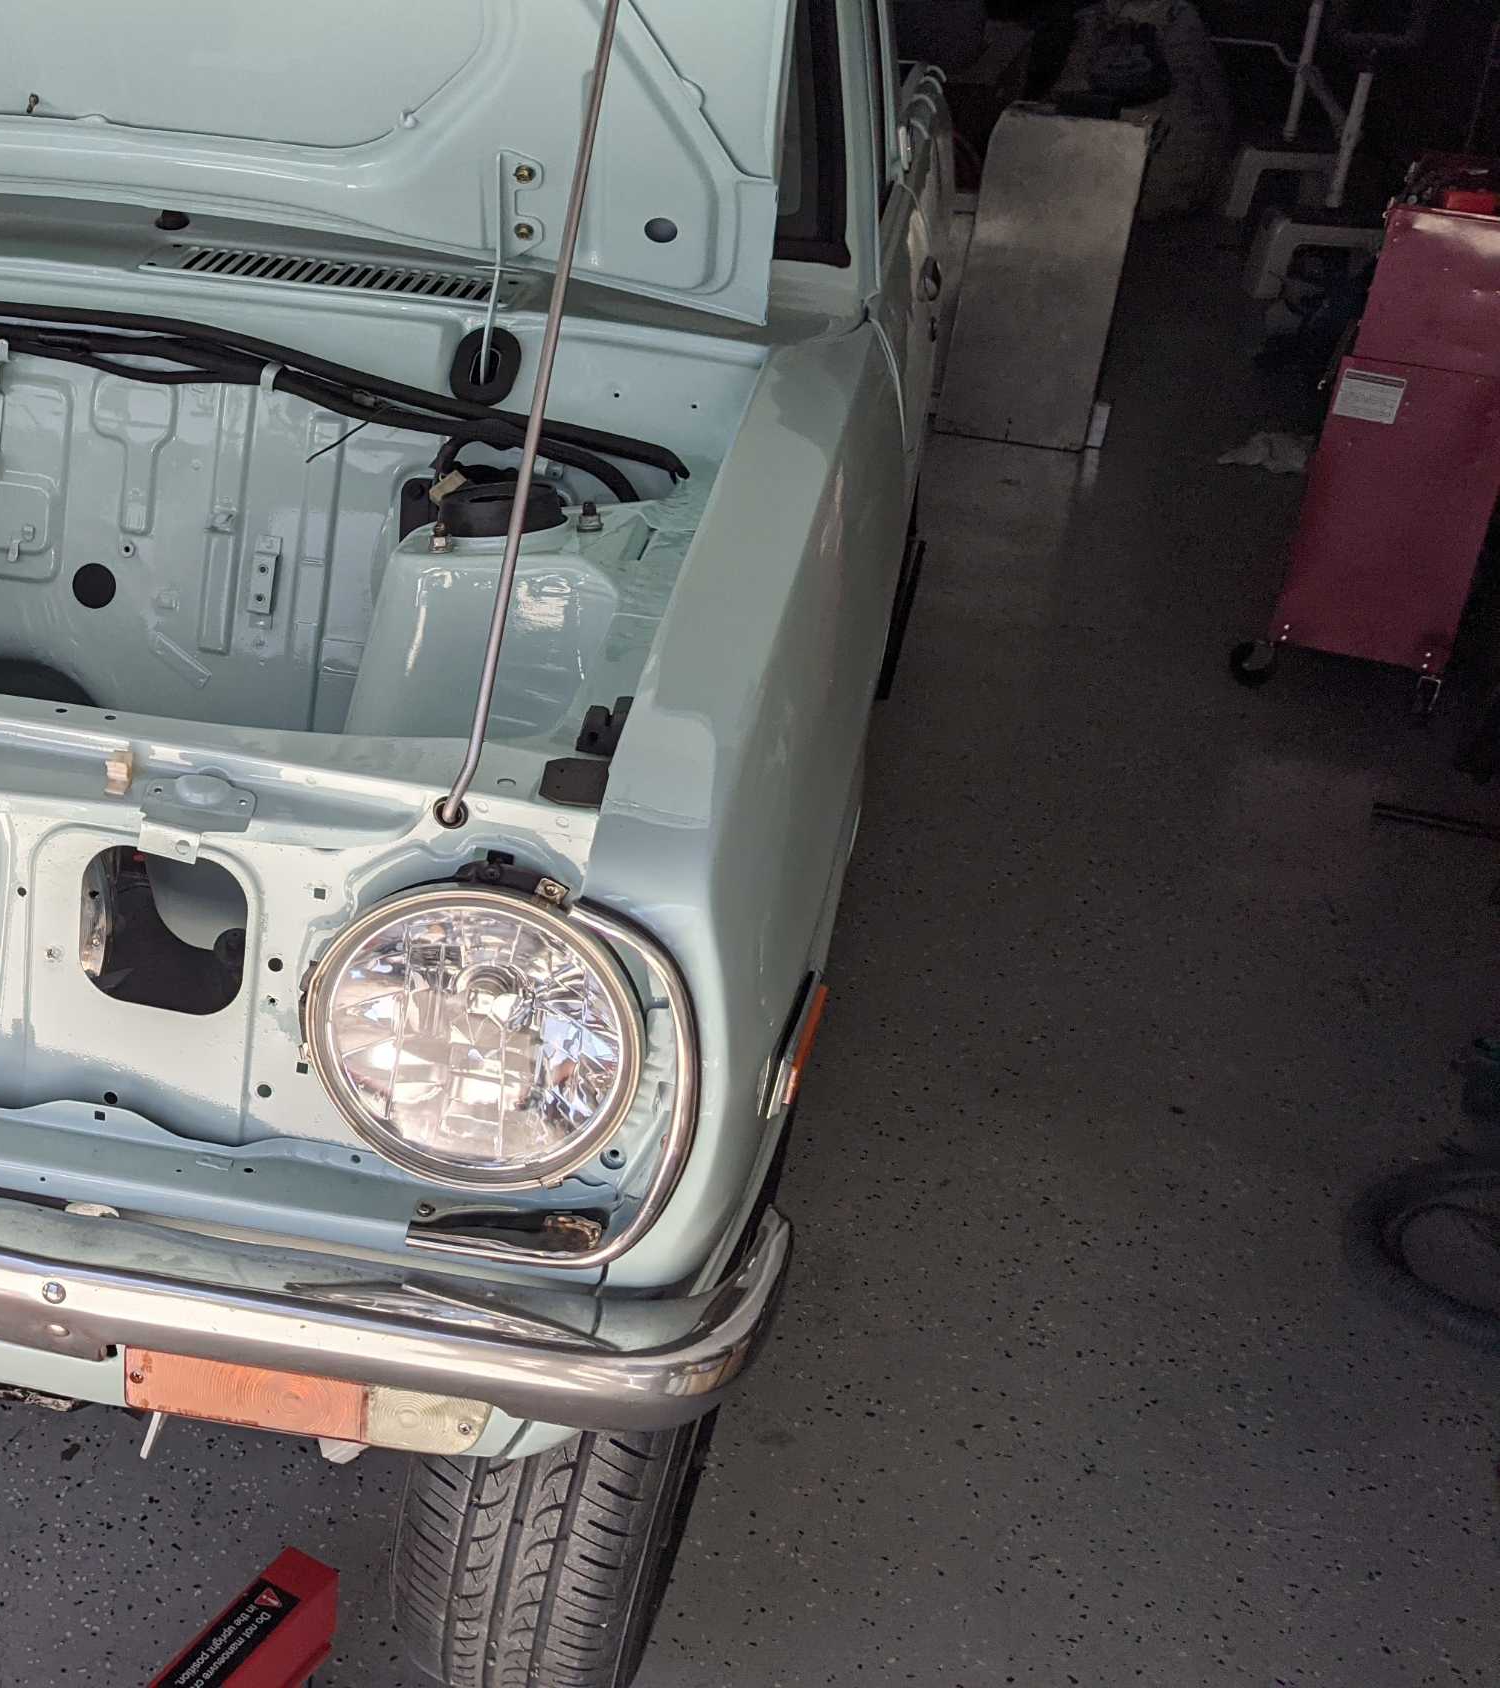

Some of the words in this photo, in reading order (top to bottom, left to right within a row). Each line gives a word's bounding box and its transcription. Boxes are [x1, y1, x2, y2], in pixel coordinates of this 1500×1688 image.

[246, 1603, 258, 1614] in
[233, 1612, 250, 1626] the
[255, 1611, 271, 1625] Do
[242, 1624, 258, 1639] not
[206, 1625, 236, 1654] upright
[202, 1636, 245, 1680] manoeuvre
[174, 1651, 210, 1685] position.
